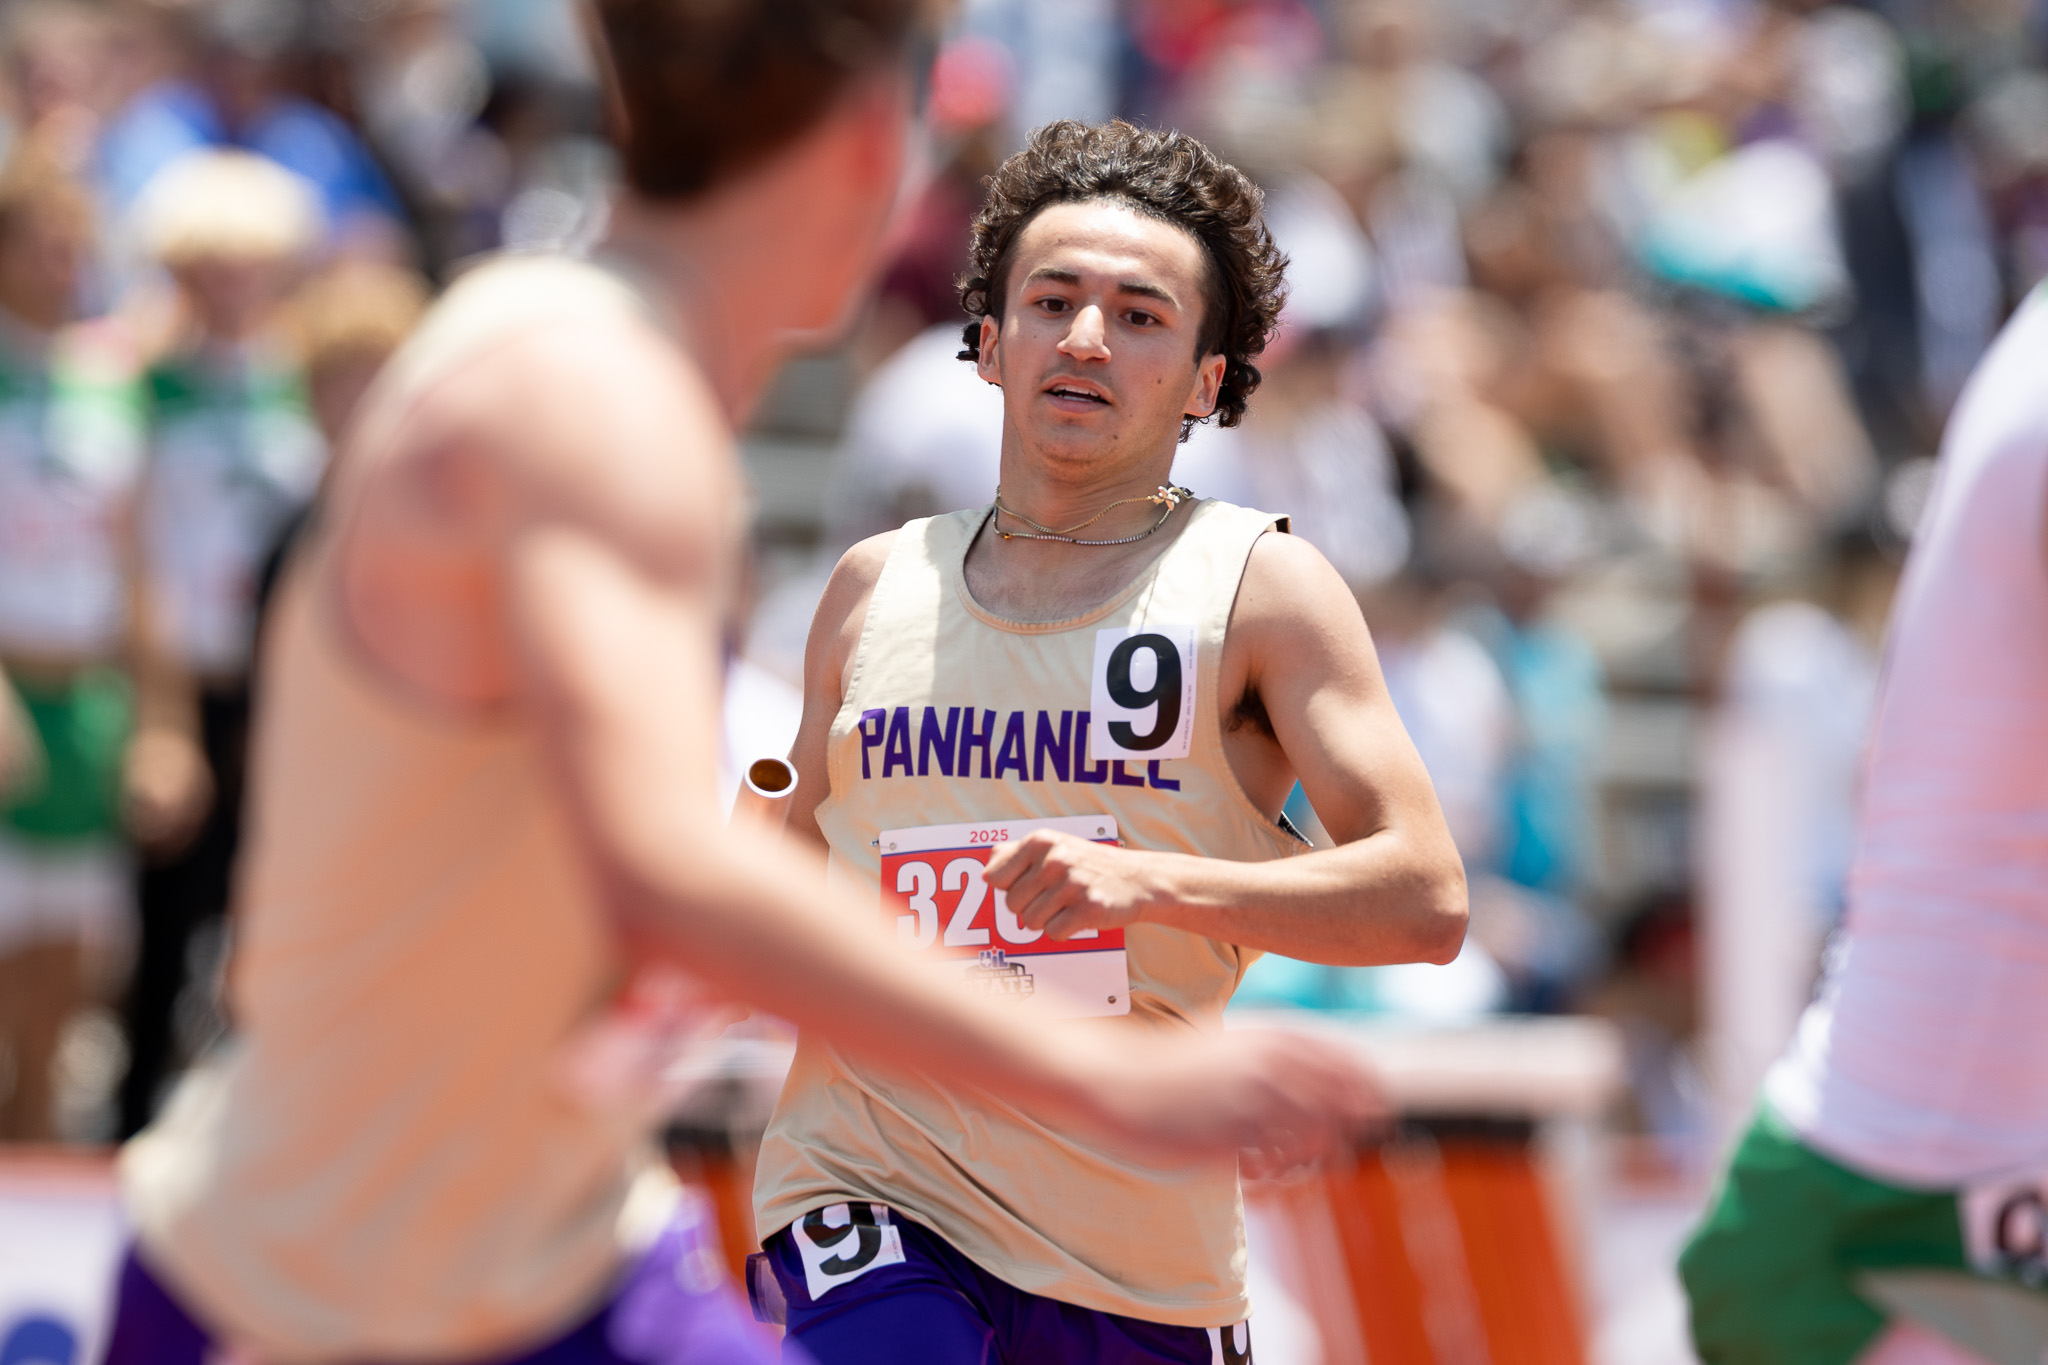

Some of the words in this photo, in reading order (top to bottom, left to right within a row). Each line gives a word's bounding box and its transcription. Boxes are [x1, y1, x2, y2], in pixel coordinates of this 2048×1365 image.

[1106, 633, 1182, 751] 9
[970, 829, 1009, 843] 2025
[803, 1202, 882, 1276] 9
